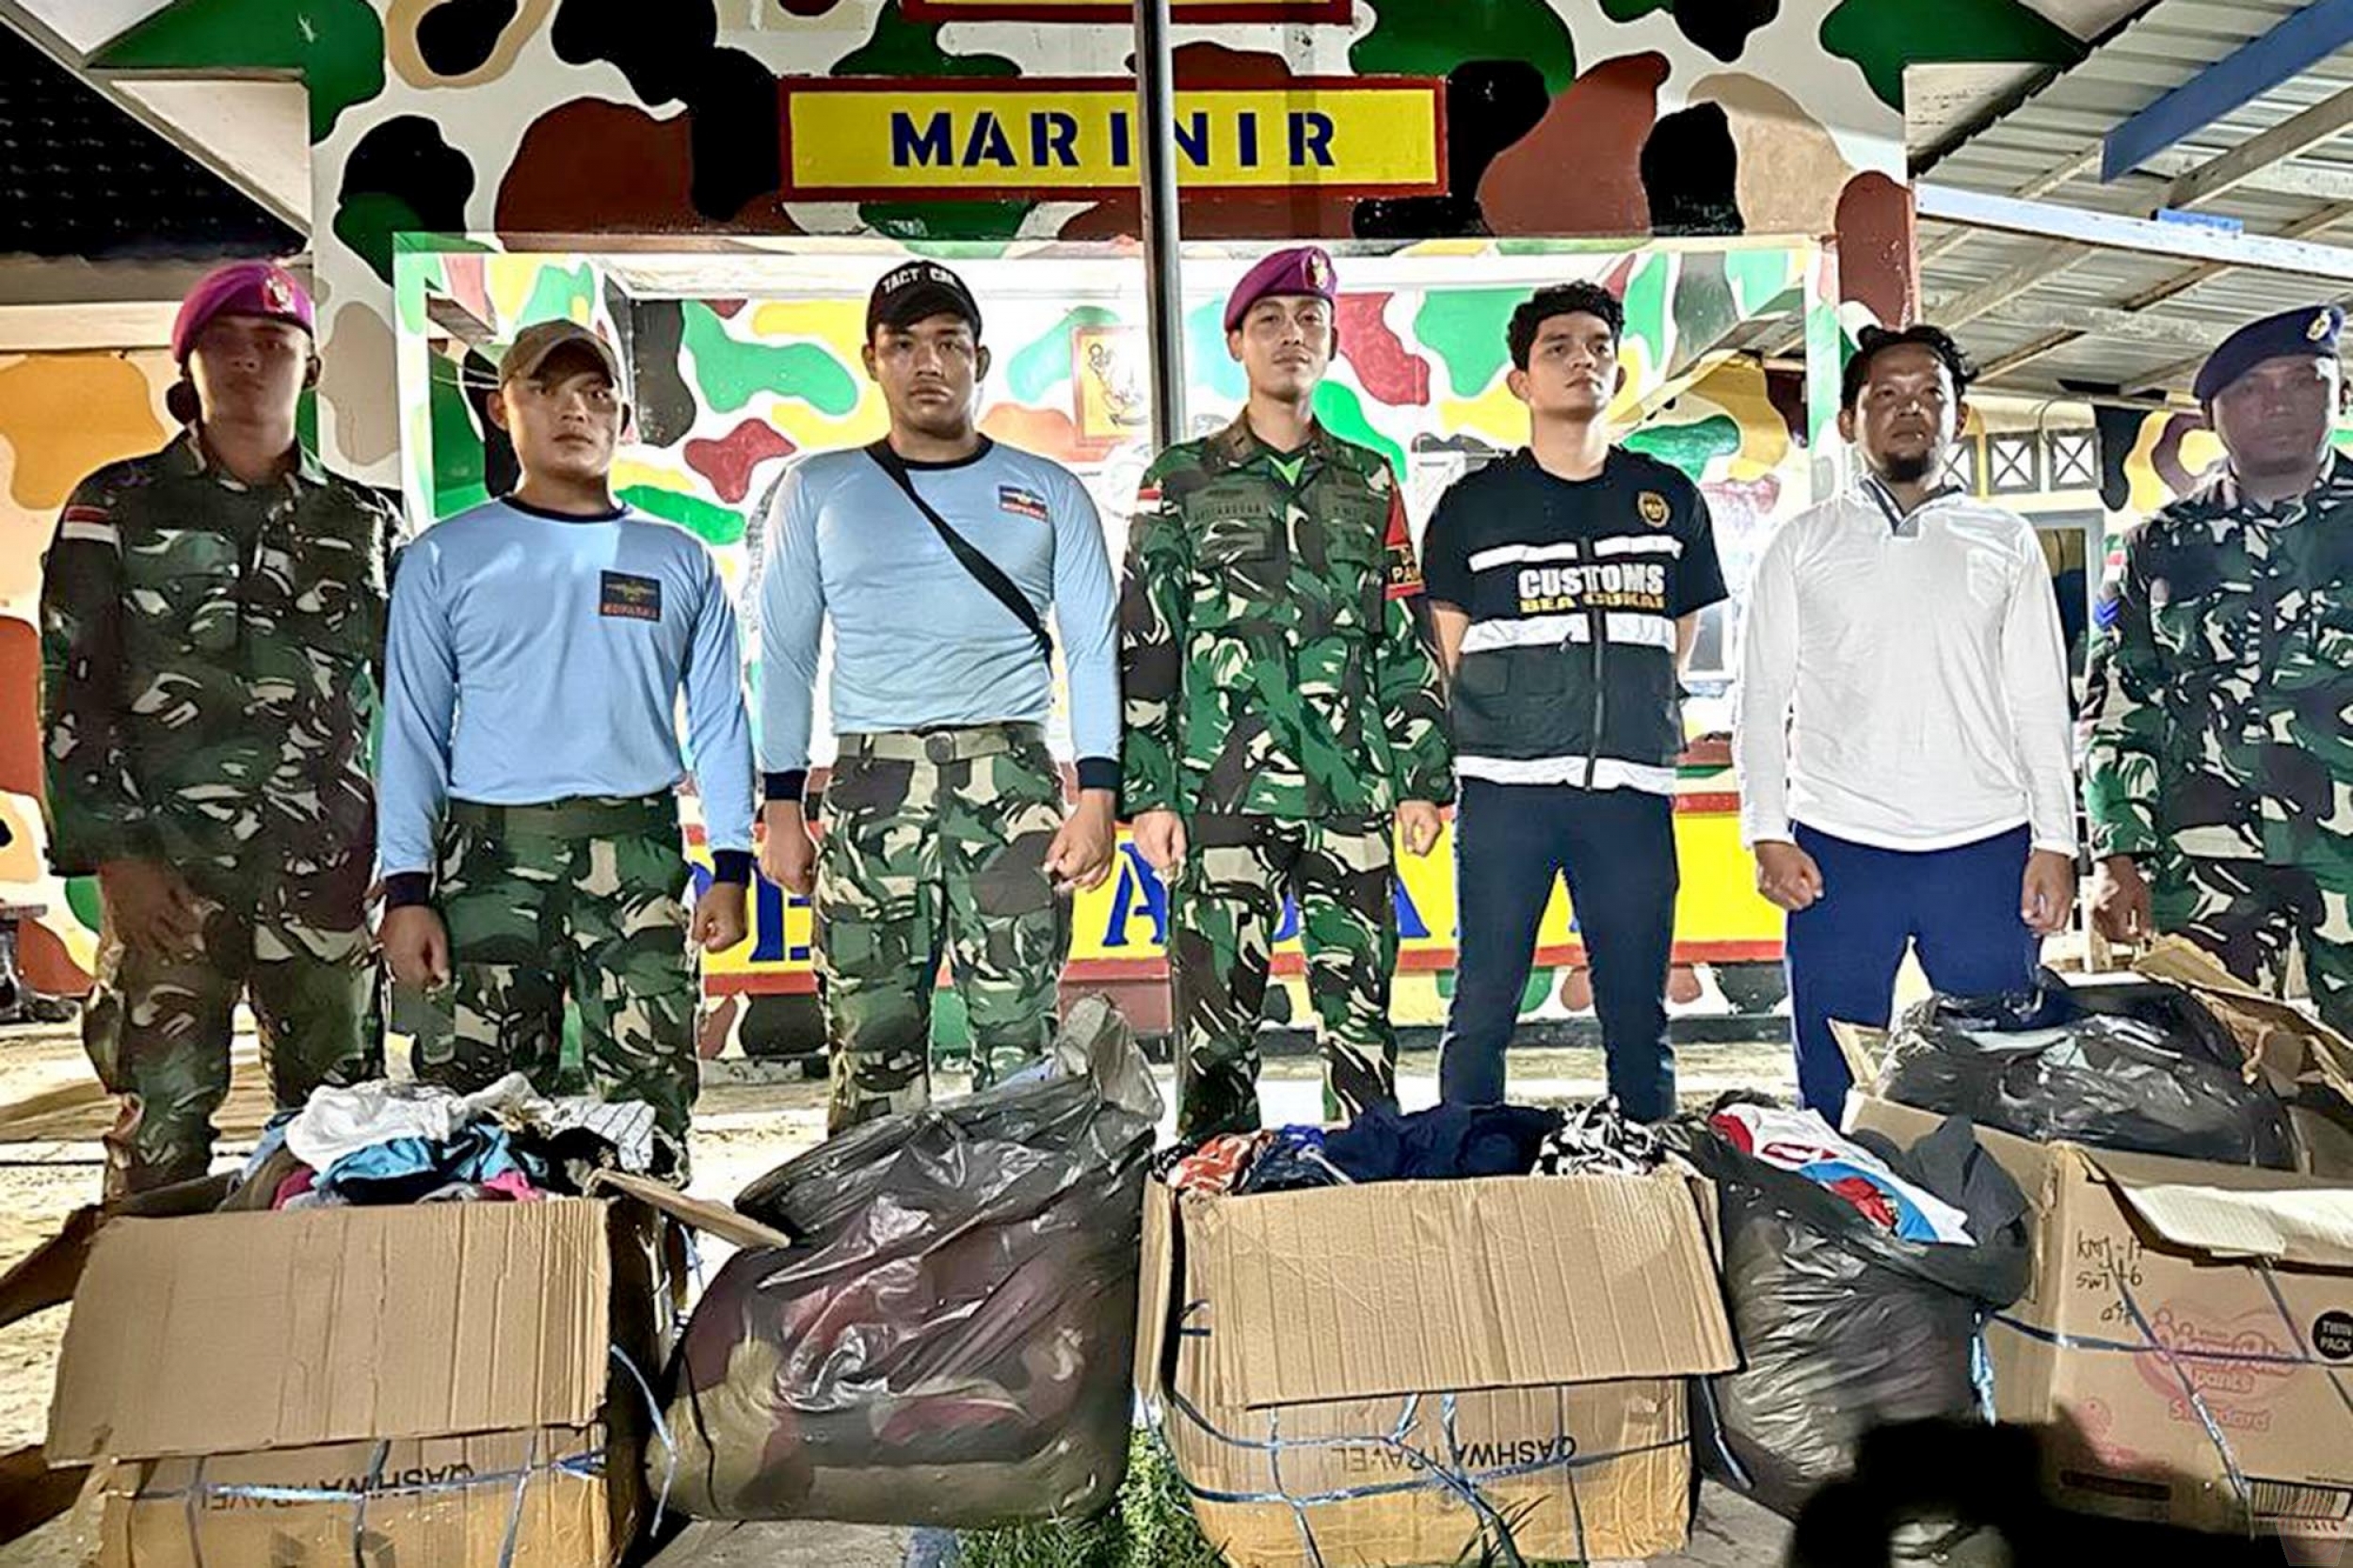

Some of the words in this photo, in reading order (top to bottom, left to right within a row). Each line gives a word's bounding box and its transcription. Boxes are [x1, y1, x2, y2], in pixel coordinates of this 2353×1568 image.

[891, 110, 1337, 168] MARINIR
[882, 267, 920, 294] TACT
[1517, 564, 1666, 598] CUSTOMS
[1519, 596, 1577, 613] BEA
[1582, 593, 1666, 610] CUKAI
[2319, 1336, 2351, 1352] PACK
